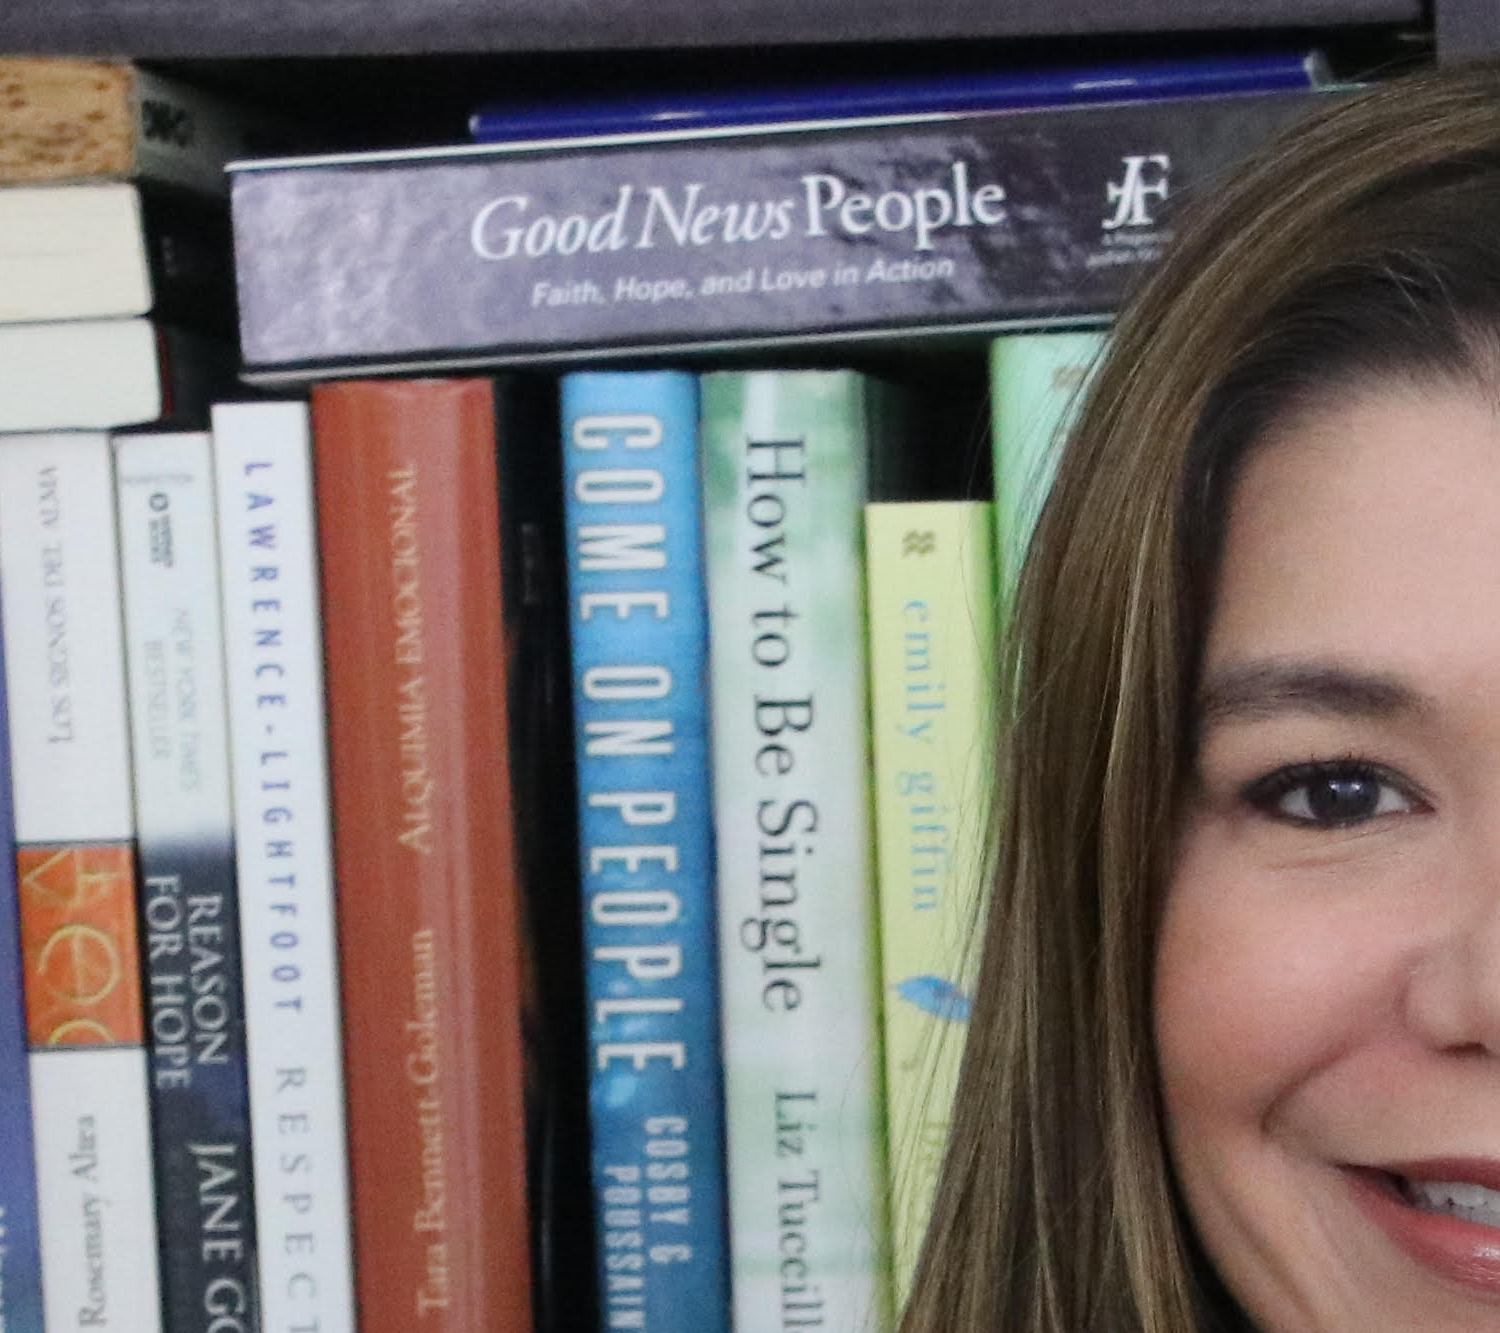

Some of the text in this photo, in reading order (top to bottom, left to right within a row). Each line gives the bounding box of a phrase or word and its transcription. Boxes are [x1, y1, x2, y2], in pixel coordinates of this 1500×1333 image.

[472, 161, 1005, 260] Good News People
[532, 255, 955, 308] Faith, Hope, and Love in Action
[242, 461, 303, 1016] LAWRENCE-LIGHTFOOT
[572, 413, 684, 1073] COME ON PEOPLE
[740, 433, 821, 1012] How to Be Single
[898, 599, 952, 911] emily giffin
[145, 873, 192, 1090] FOR HOPE
[186, 892, 229, 1066] REASON
[645, 1116, 693, 1264] COSBY &
[773, 1090, 818, 1158] Liz
[76, 1192, 113, 1328] Rosemary
[188, 1142, 242, 1262] JANE
[414, 1241, 450, 1317] Tara
